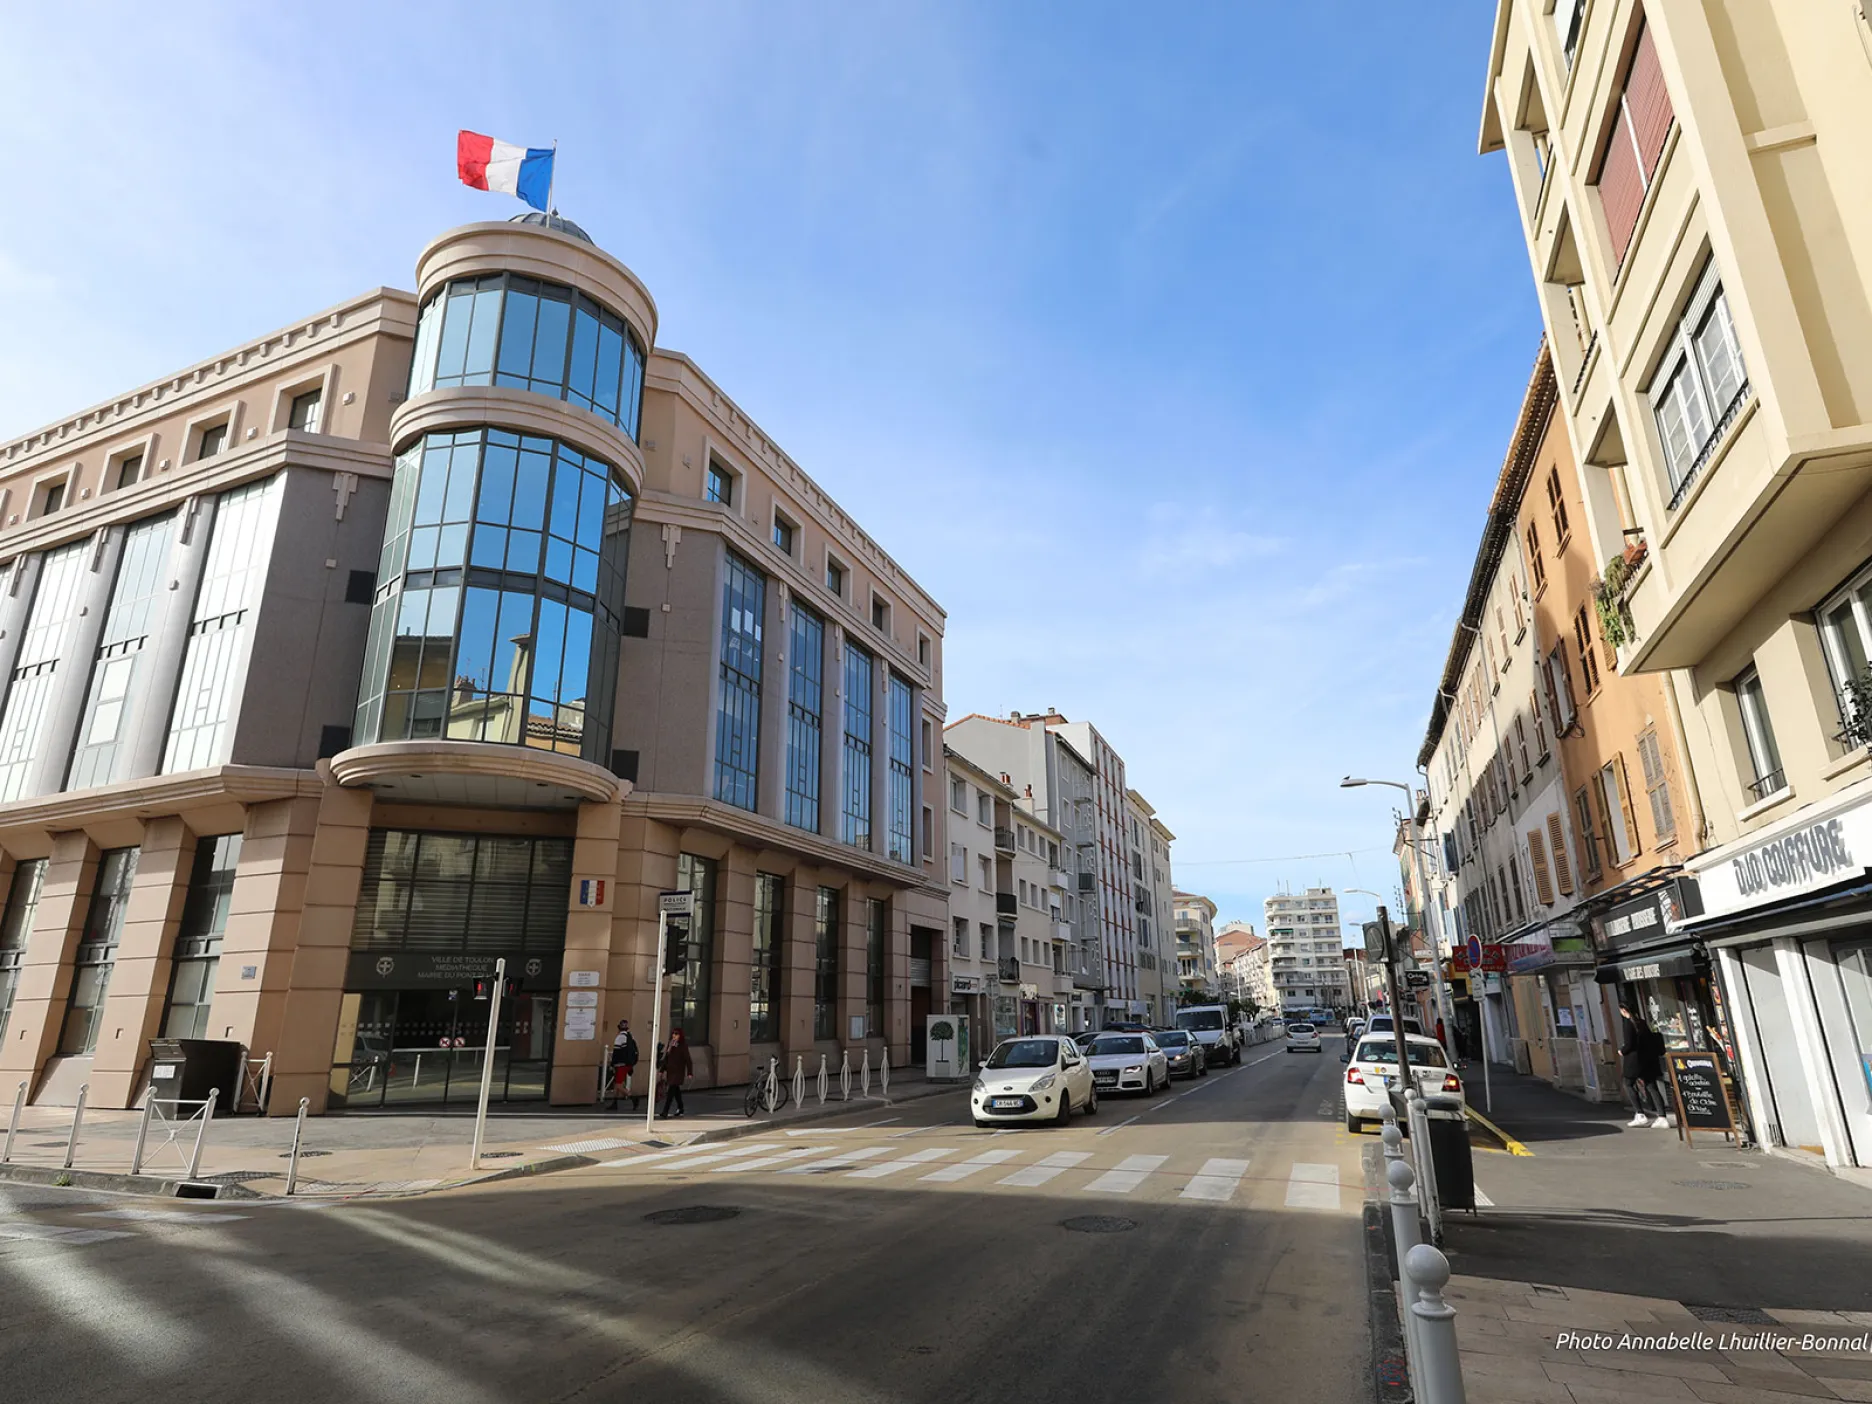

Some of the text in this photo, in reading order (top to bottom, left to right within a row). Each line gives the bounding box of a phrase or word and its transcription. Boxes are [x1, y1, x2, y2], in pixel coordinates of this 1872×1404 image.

[1732, 819, 1850, 896] DUO COIFFURE
[452, 956, 463, 964] DE
